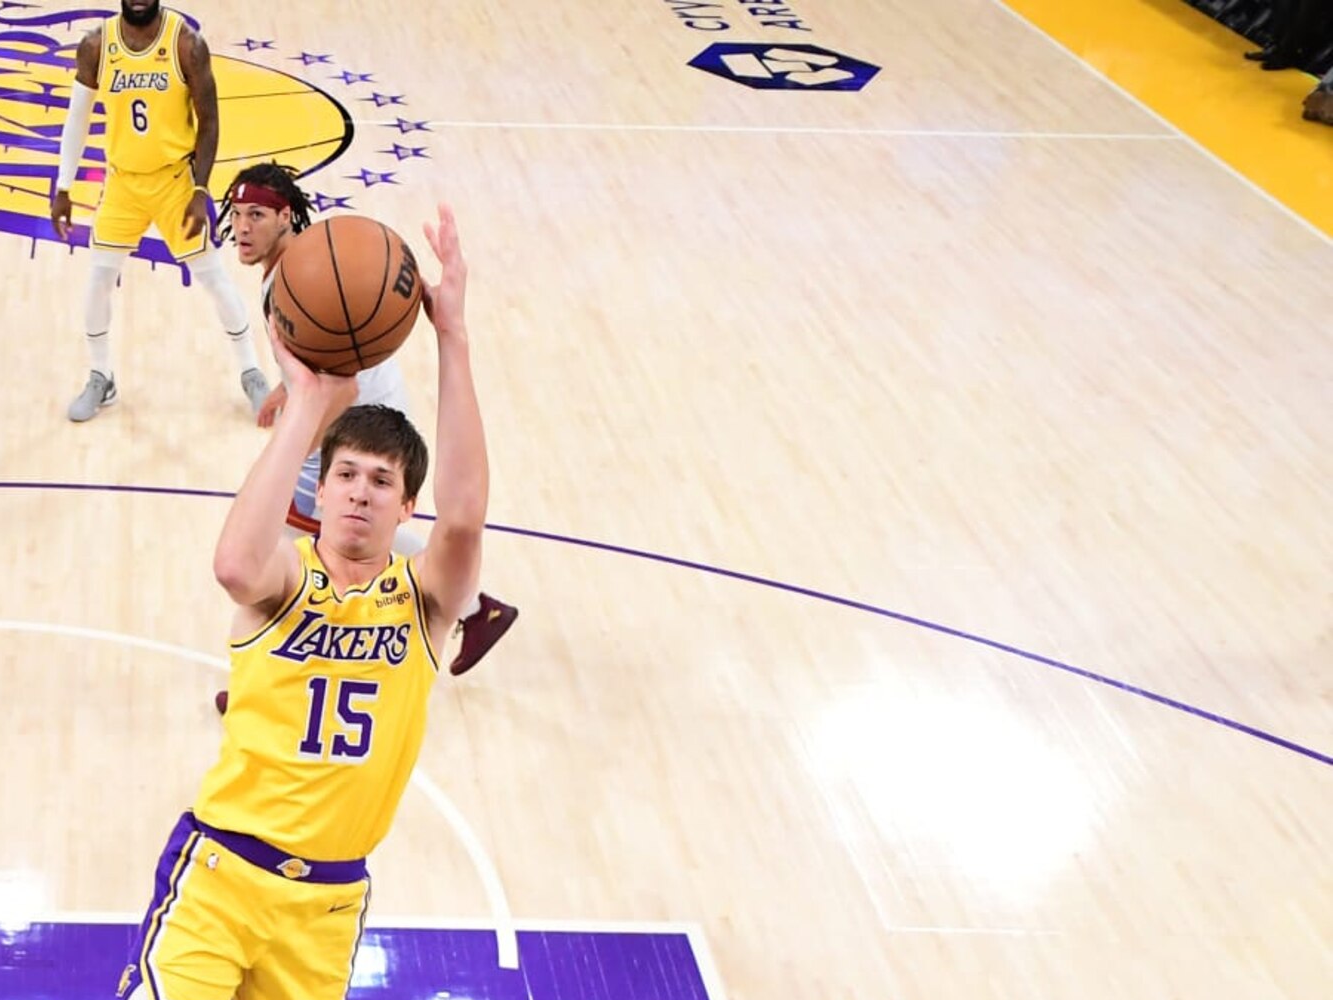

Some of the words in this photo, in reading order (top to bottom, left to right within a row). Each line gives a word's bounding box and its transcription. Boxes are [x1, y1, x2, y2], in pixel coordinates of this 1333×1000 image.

[109, 68, 170, 94] LAKERS
[131, 98, 149, 133] 6
[374, 591, 411, 608] bibigo
[269, 610, 411, 665] LAKERS
[299, 677, 379, 758] 15
